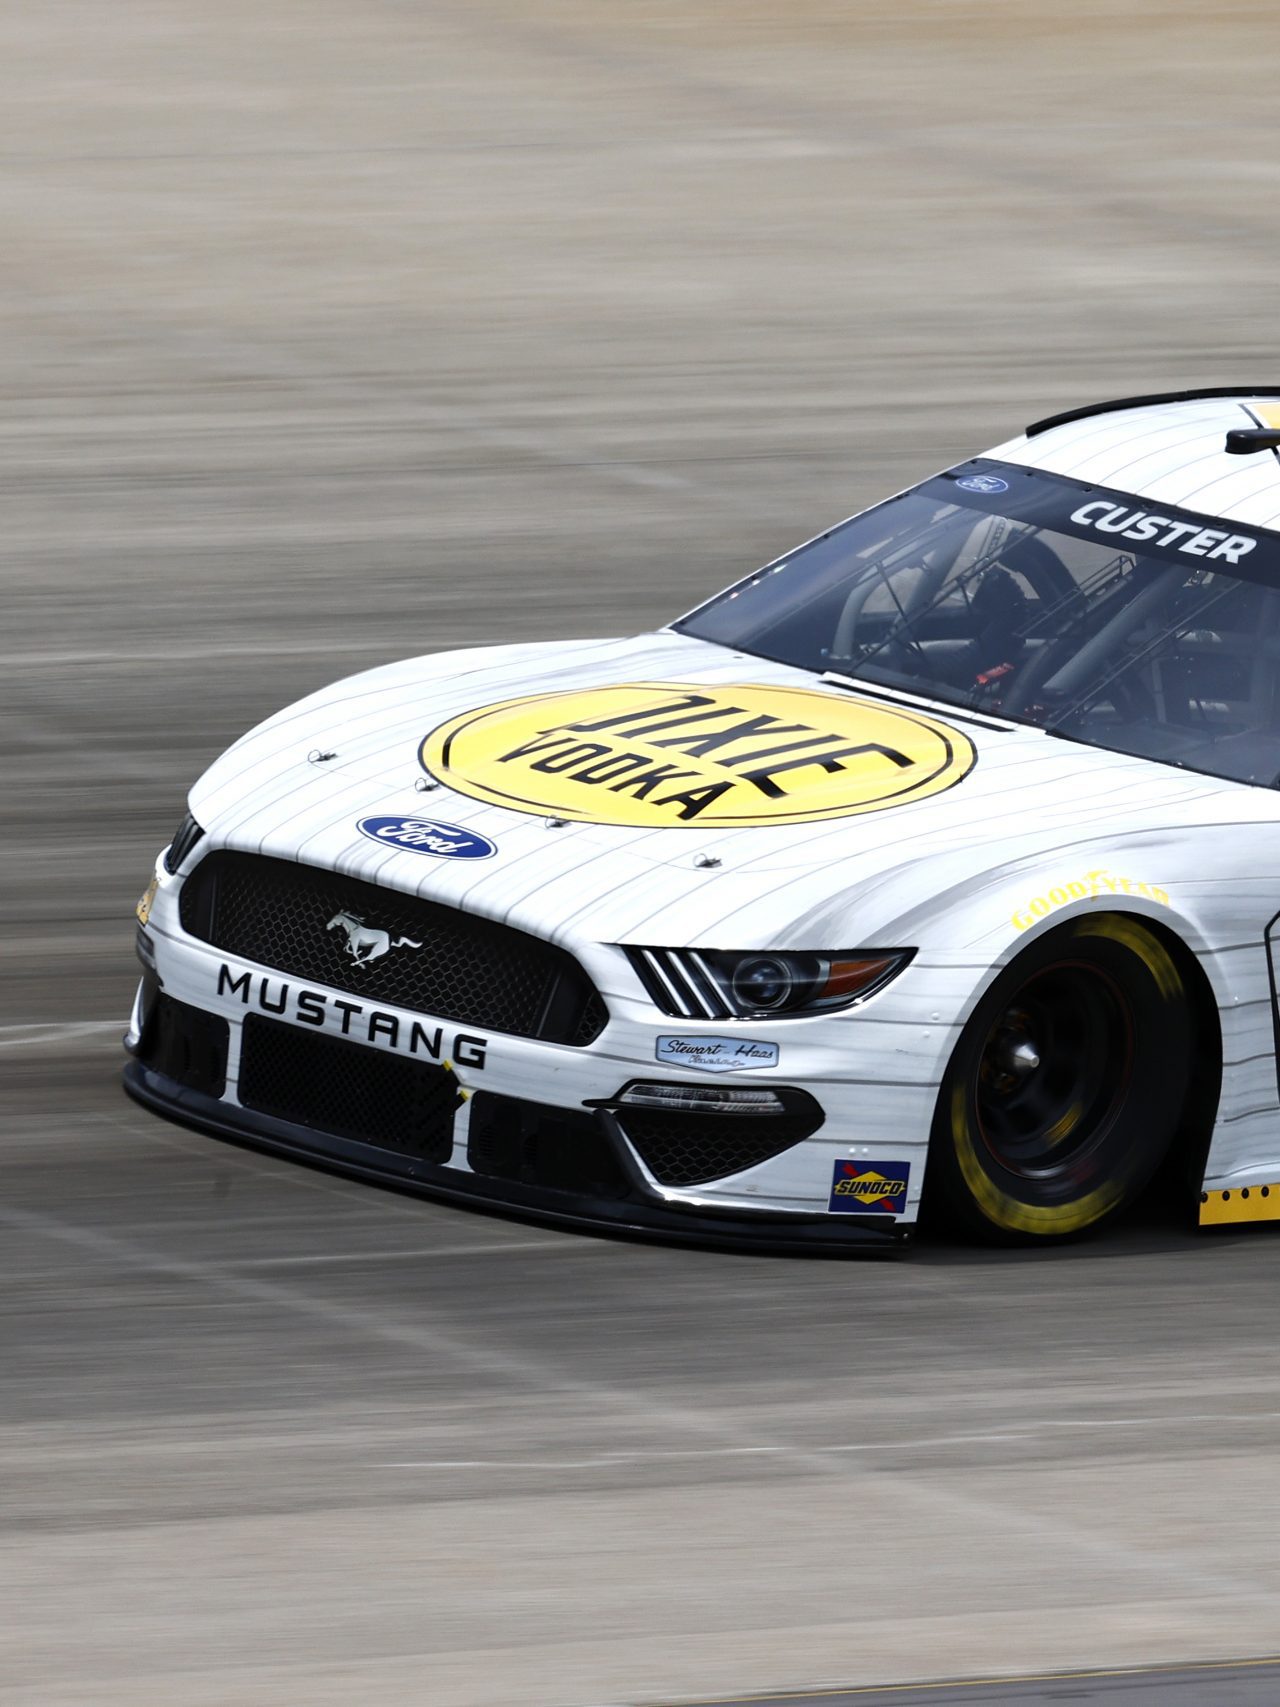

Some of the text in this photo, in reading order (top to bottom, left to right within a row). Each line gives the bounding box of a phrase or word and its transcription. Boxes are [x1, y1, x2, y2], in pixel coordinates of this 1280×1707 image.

[961, 477, 1000, 491] Ford
[1070, 500, 1257, 564] CUSTER
[535, 695, 915, 799] DIXIE
[496, 737, 738, 820] VODKA
[376, 821, 474, 853] Ford
[1011, 870, 1170, 931] GOODYEAR
[217, 964, 489, 1070] MUSTANG
[838, 1181, 903, 1195] SUNOCO
